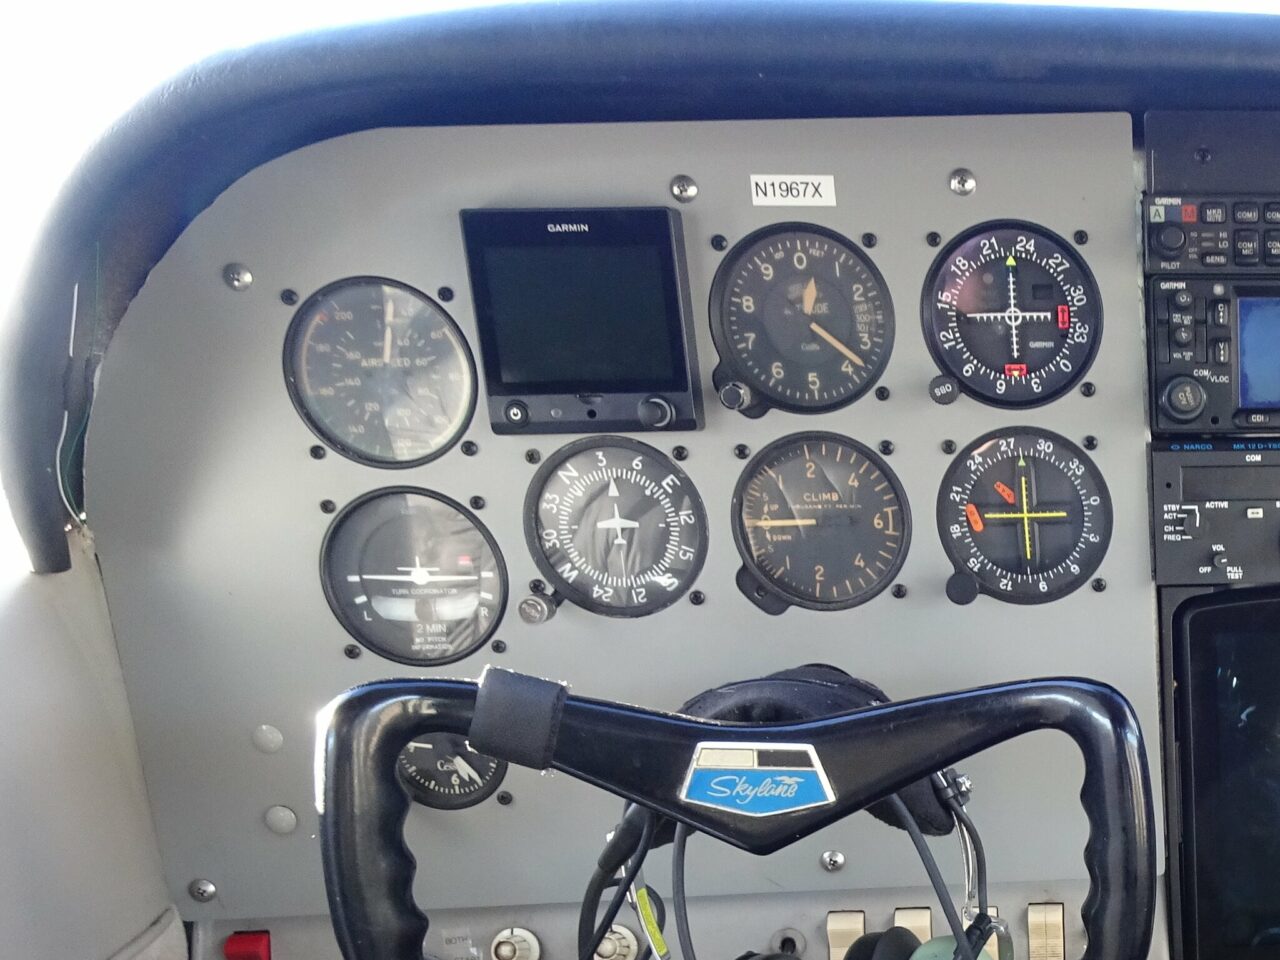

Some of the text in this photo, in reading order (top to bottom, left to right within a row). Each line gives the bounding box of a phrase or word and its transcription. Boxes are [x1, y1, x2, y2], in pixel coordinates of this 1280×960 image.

[755, 181, 823, 199] N1967X
[1155, 197, 1181, 205] GARMIN
[1153, 209, 1162, 219] A
[547, 223, 589, 232] GARMIN
[980, 236, 999, 255] 21
[1016, 236, 1035, 253] 24
[950, 256, 969, 276] 18
[1048, 253, 1070, 272] 27
[1160, 262, 1181, 270] PILOT
[761, 263, 774, 280] 9
[852, 284, 865, 301] 2
[1160, 282, 1186, 290] GARMIN
[742, 296, 755, 313] 8
[937, 290, 952, 310] 15
[1070, 285, 1087, 307] 30
[939, 328, 956, 350] 12
[1073, 322, 1089, 344] 33
[772, 362, 785, 379] 6
[808, 373, 820, 390] 5
[999, 437, 1015, 451] 27
[1036, 439, 1053, 452] 30
[595, 451, 607, 467] 3
[632, 456, 643, 470] 6
[1069, 458, 1085, 475] 33
[557, 463, 580, 485] N
[660, 473, 681, 494] E
[803, 492, 839, 502] CLIMB
[950, 485, 962, 502] 21
[542, 492, 560, 513] 33
[542, 529, 560, 549] 30
[950, 524, 962, 538] 18
[679, 545, 695, 561] 15
[558, 562, 580, 583] W
[364, 611, 372, 621] L
[481, 607, 489, 617] R
[416, 624, 447, 633] 2 MIN
[451, 774, 460, 785] 6
[707, 776, 799, 804] Skylane
[445, 937, 468, 946] BOTH
